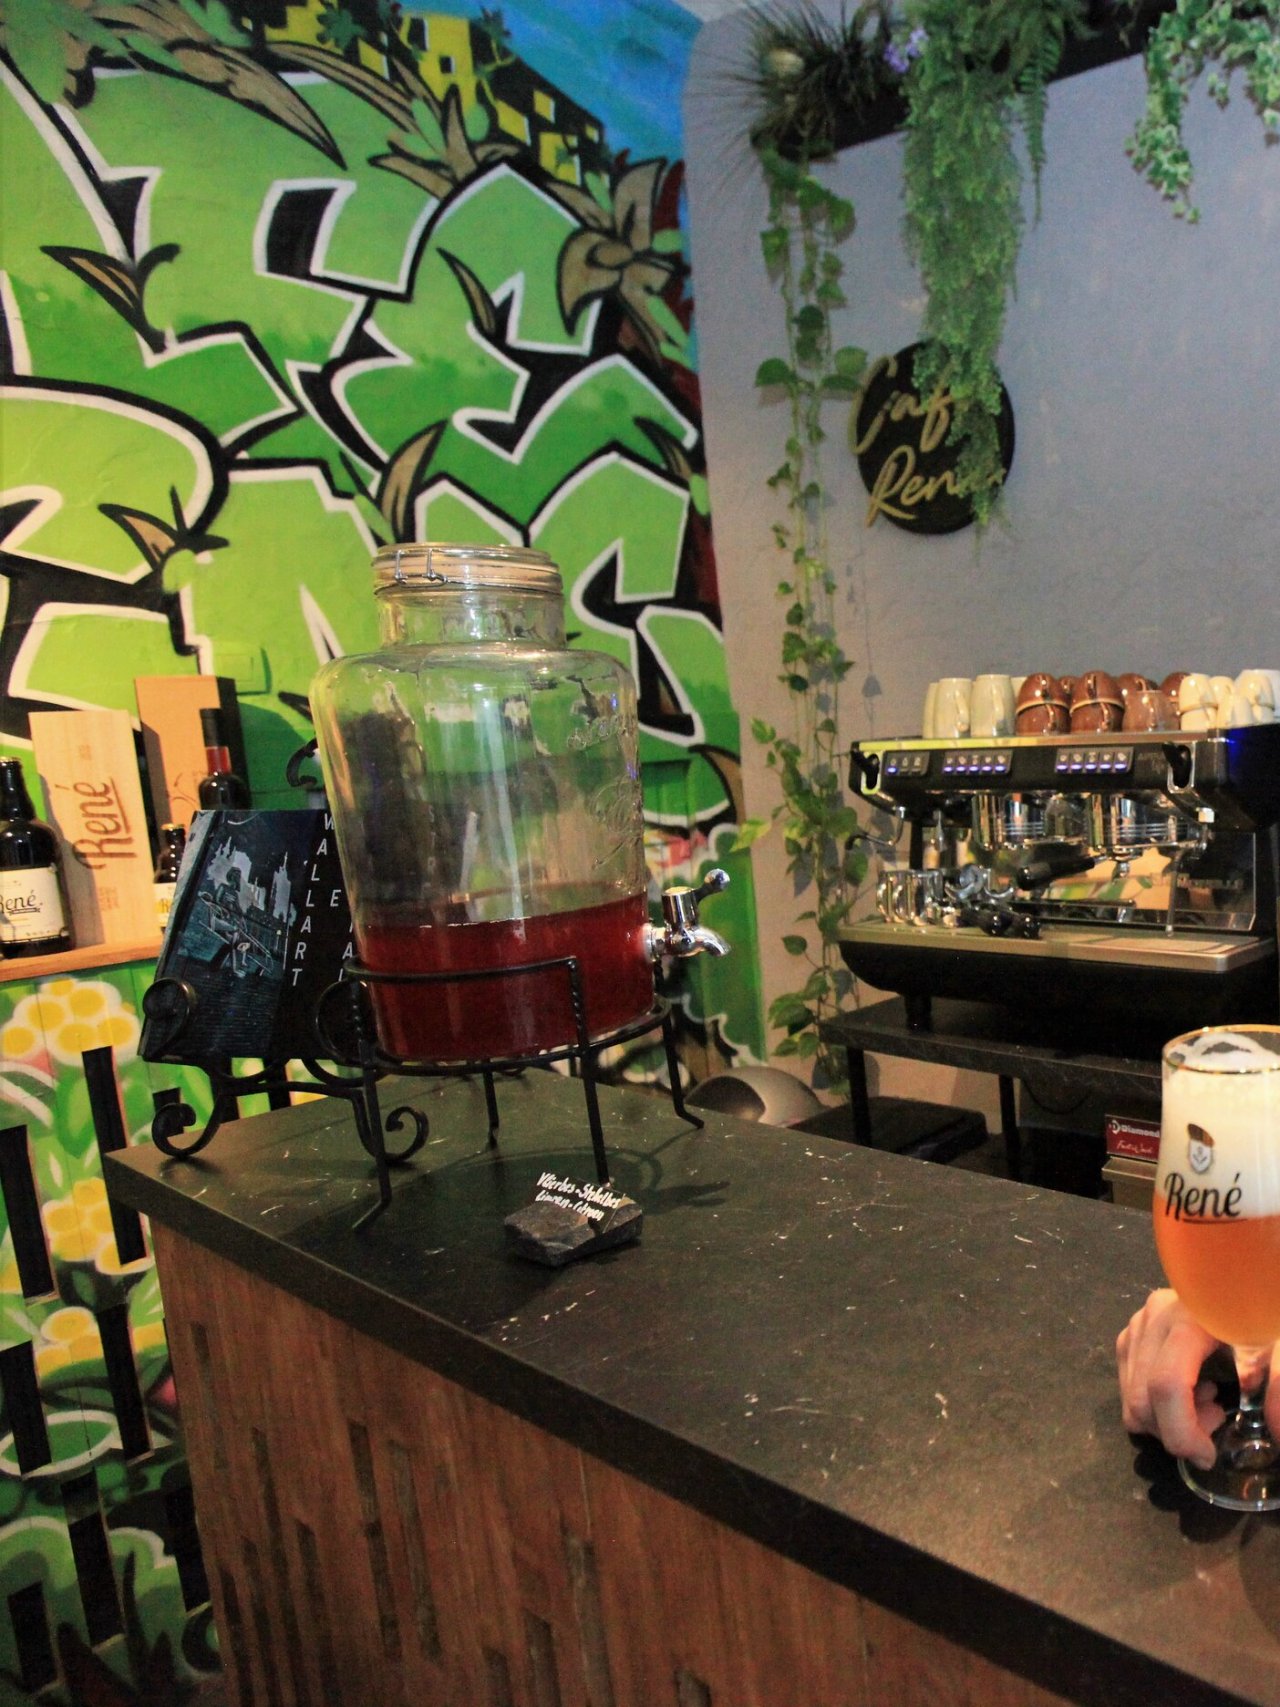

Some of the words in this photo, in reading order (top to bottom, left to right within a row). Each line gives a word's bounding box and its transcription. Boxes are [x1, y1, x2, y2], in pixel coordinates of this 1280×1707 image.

[847, 354, 968, 455] Caf
[865, 443, 1007, 529] Ren
[55, 779, 138, 870] René
[1164, 1172, 1243, 1222] René
